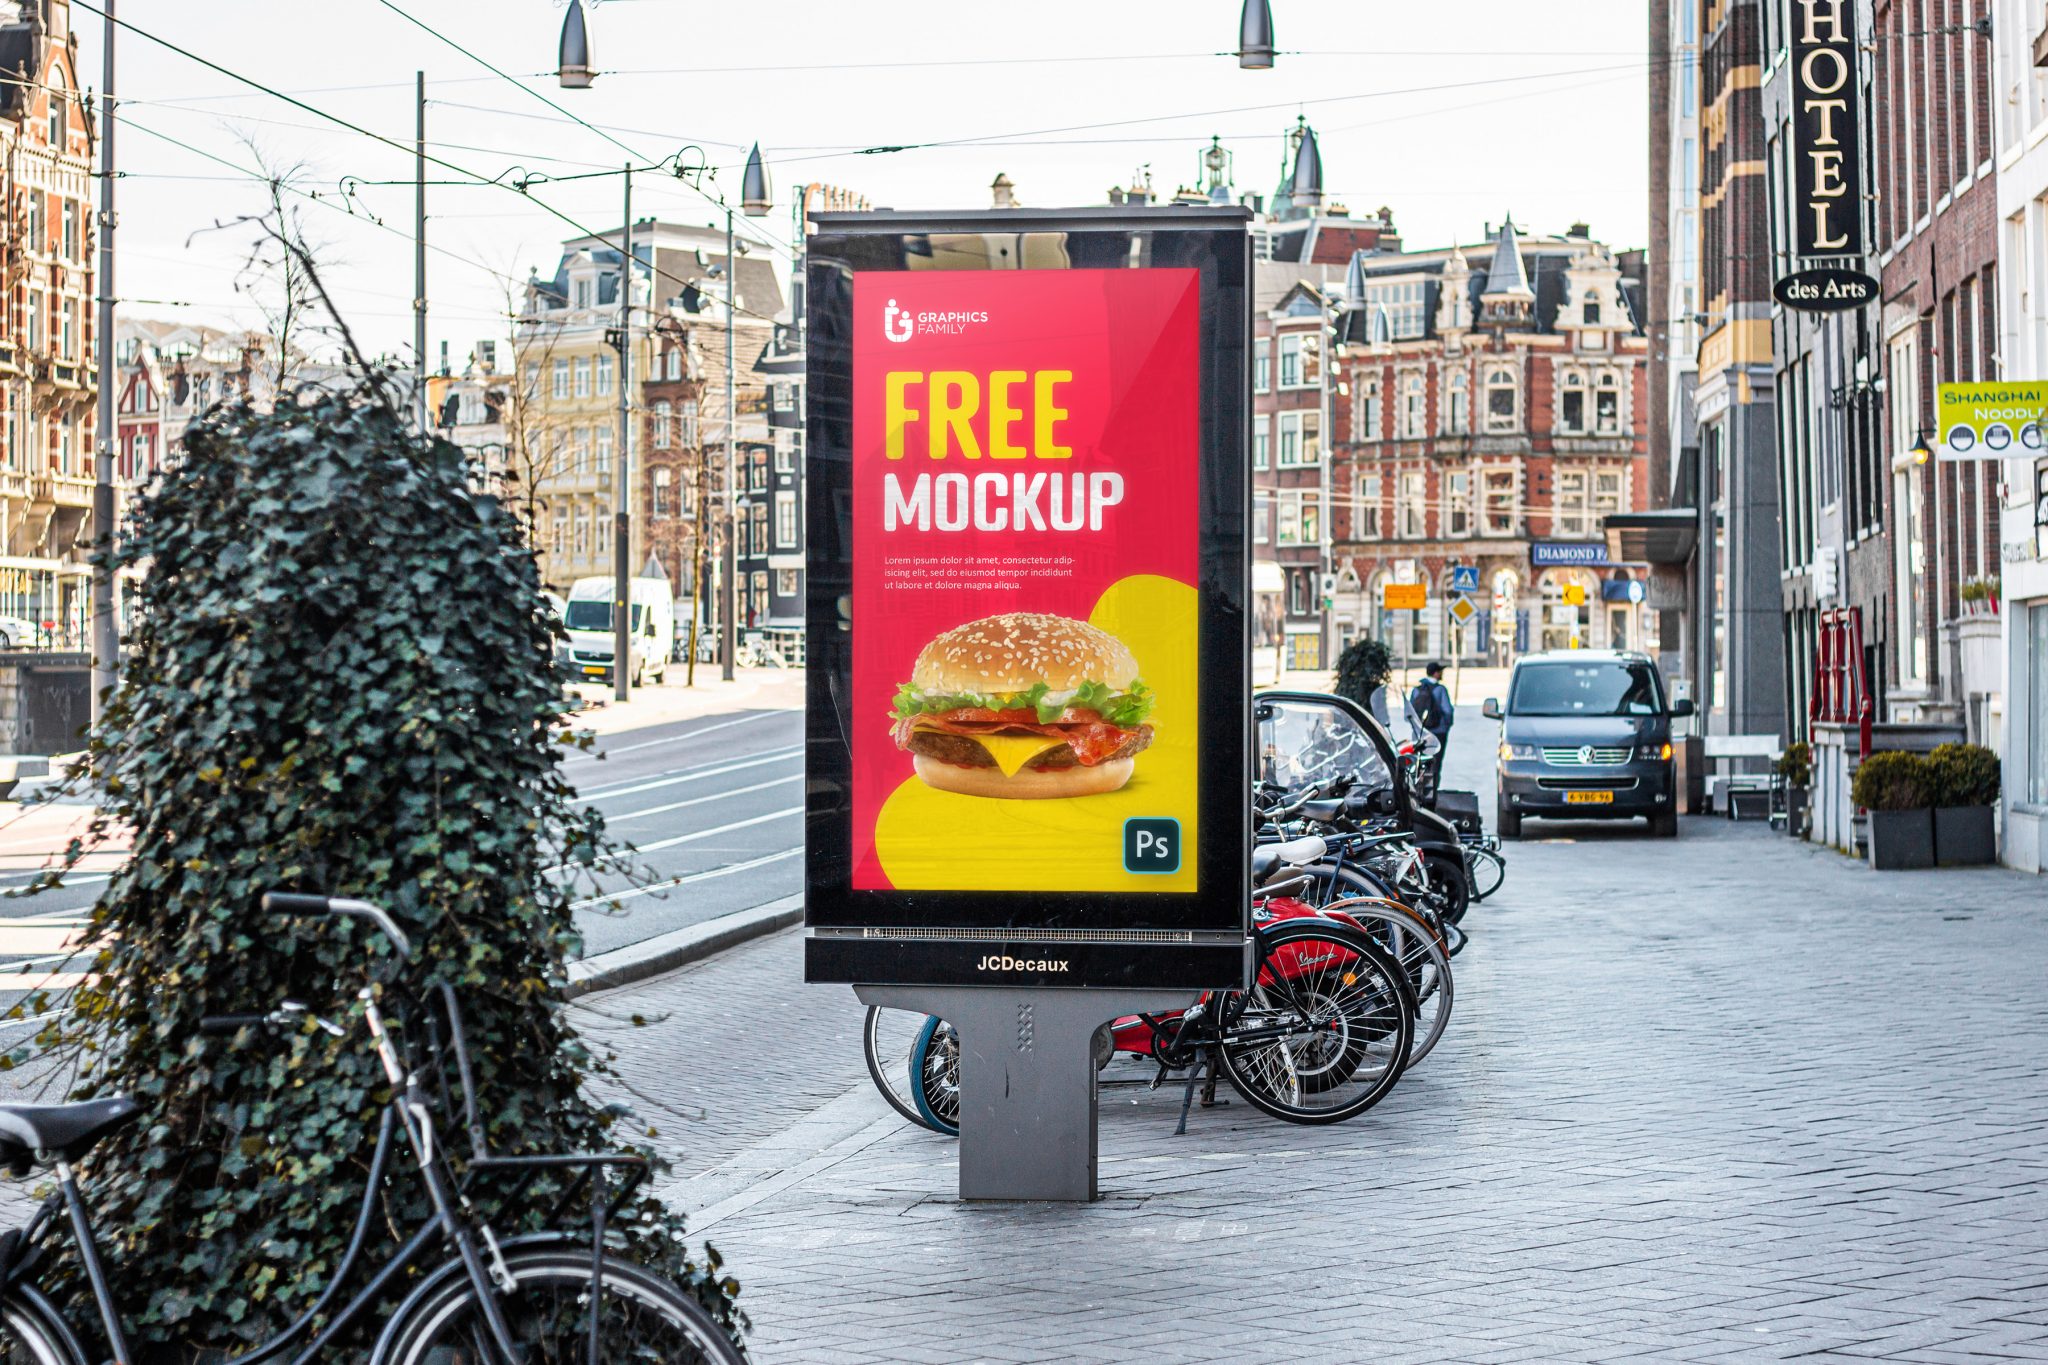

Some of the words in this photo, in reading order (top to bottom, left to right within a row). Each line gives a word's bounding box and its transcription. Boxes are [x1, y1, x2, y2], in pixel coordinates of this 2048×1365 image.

[1799, 0, 1848, 249] HOTEL
[1786, 278, 1819, 299] des
[1823, 278, 1867, 299] Arts
[918, 311, 989, 323] GRAPHICS
[918, 323, 966, 335] FAMILY
[1944, 390, 2041, 405] SHANGHAI
[886, 370, 1073, 460] FREE
[884, 472, 1125, 532] MOCKUP
[884, 555, 911, 564] Lorem
[913, 555, 938, 566] ipsum
[940, 555, 962, 564] dolor
[964, 555, 975, 564] sit
[976, 555, 1000, 565] amet,
[1002, 555, 1052, 564] consectetur
[1054, 555, 1076, 566] adip-
[1538, 547, 1595, 560] DIAMOND
[884, 567, 911, 578] isicing
[912, 567, 928, 577] elit,
[930, 567, 945, 576] sed
[946, 567, 958, 576] do
[960, 567, 995, 576] eiusmod
[997, 567, 1029, 578] tempor
[1030, 567, 1073, 576] incididunt
[884, 581, 894, 589] ut
[895, 580, 923, 589] labore
[924, 581, 933, 589] et
[934, 580, 962, 589] dolore
[964, 581, 992, 590] magna
[994, 580, 1022, 590] aliqua.
[1136, 830, 1169, 858] Ps
[977, 955, 1069, 972] JCDecaux
